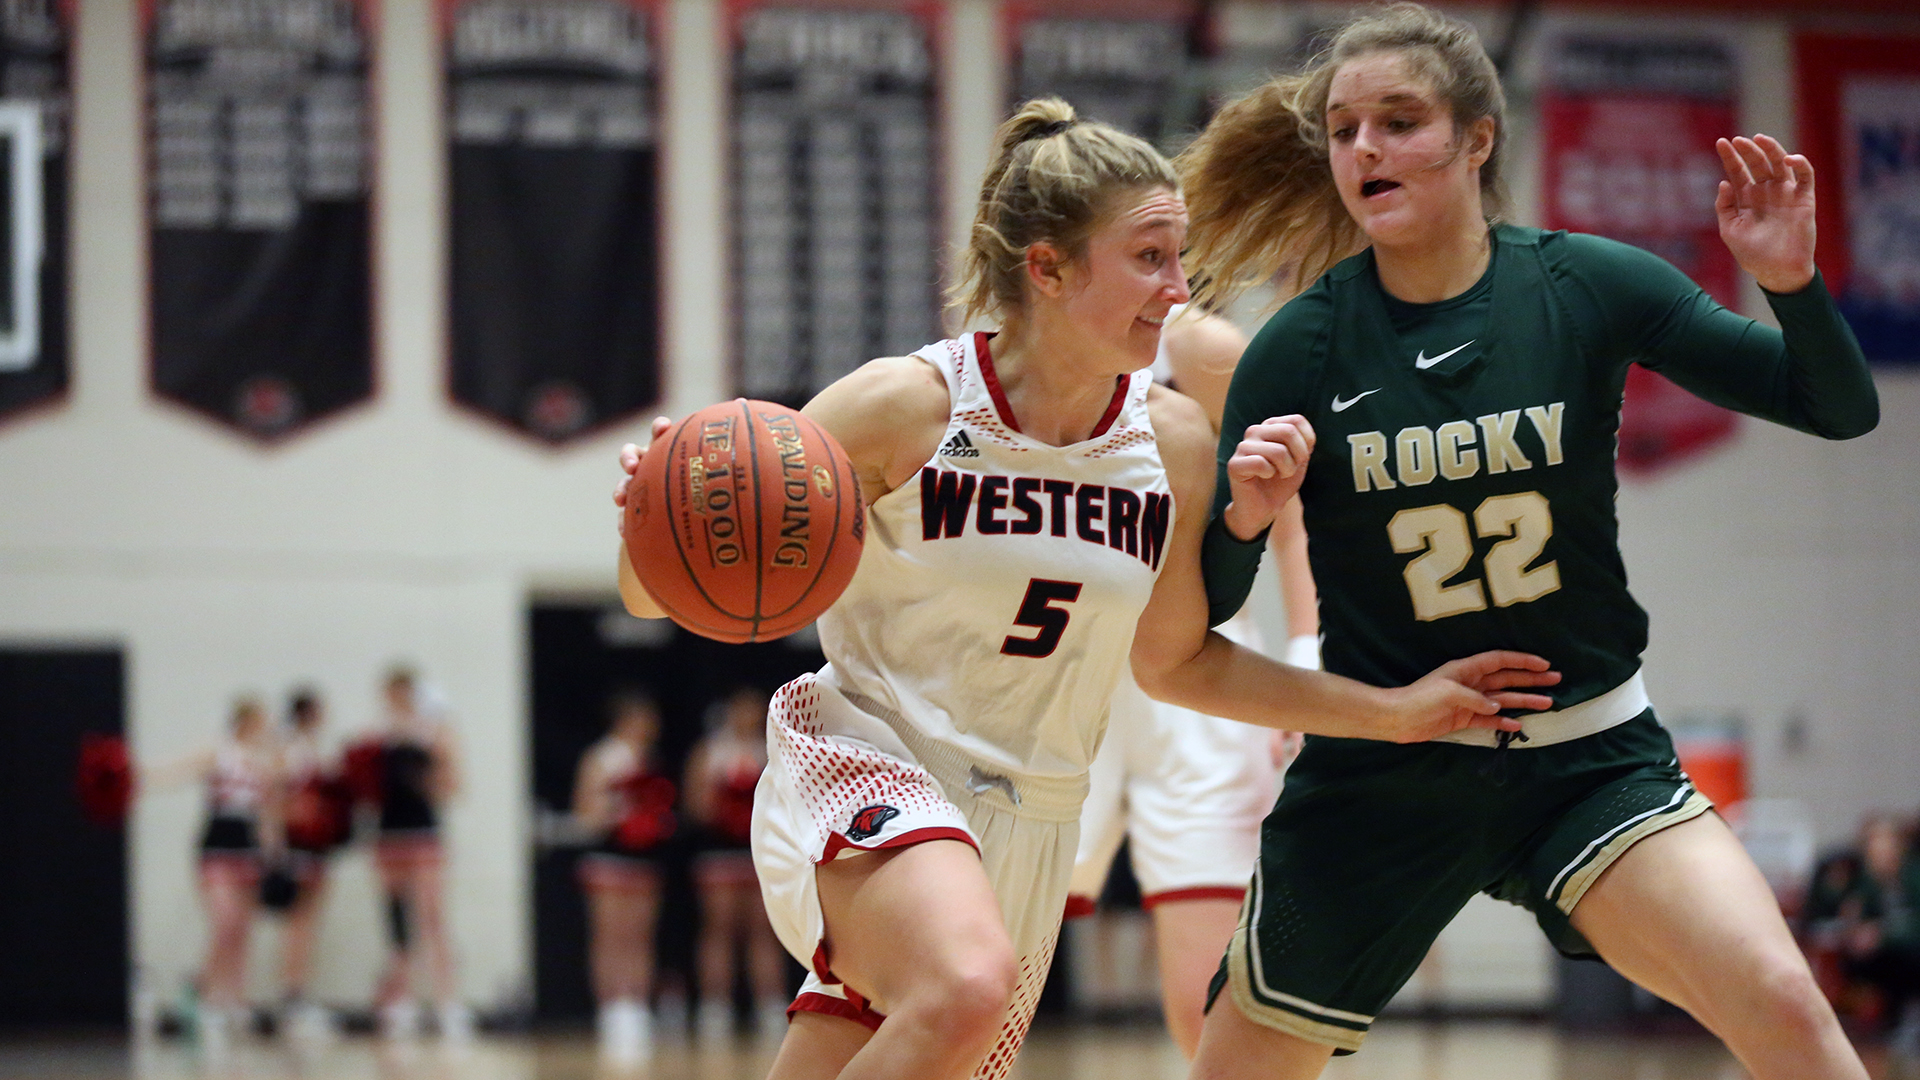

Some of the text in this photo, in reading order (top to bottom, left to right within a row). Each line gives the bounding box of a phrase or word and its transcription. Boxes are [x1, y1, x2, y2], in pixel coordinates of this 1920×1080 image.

[689, 456, 707, 515] LEGACY
[759, 411, 808, 568] SPALDING
[939, 445, 980, 458] adidas
[1346, 401, 1565, 493] ROCKY
[920, 466, 1170, 573] WESTERN
[1386, 490, 1562, 622] 22
[999, 577, 1084, 659] 5
